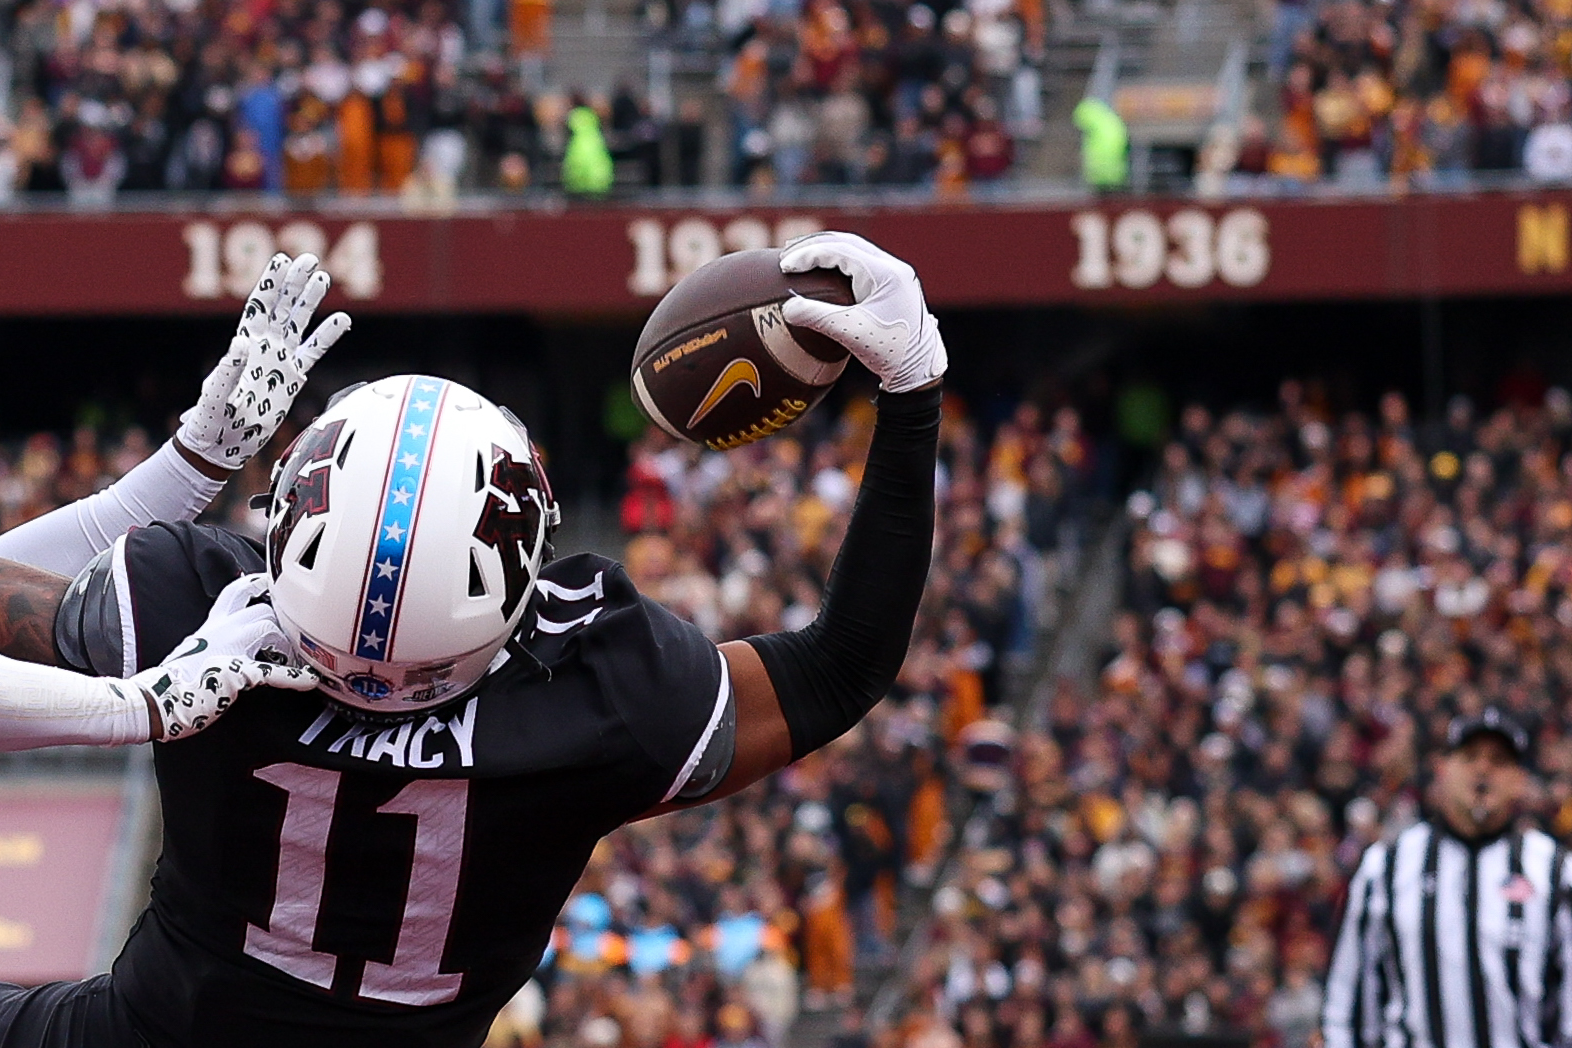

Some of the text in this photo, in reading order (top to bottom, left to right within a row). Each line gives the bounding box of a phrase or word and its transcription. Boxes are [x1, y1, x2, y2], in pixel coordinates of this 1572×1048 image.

[628, 217, 828, 296] 19
[1071, 210, 1270, 288] 1936
[242, 762, 470, 1006] 11
